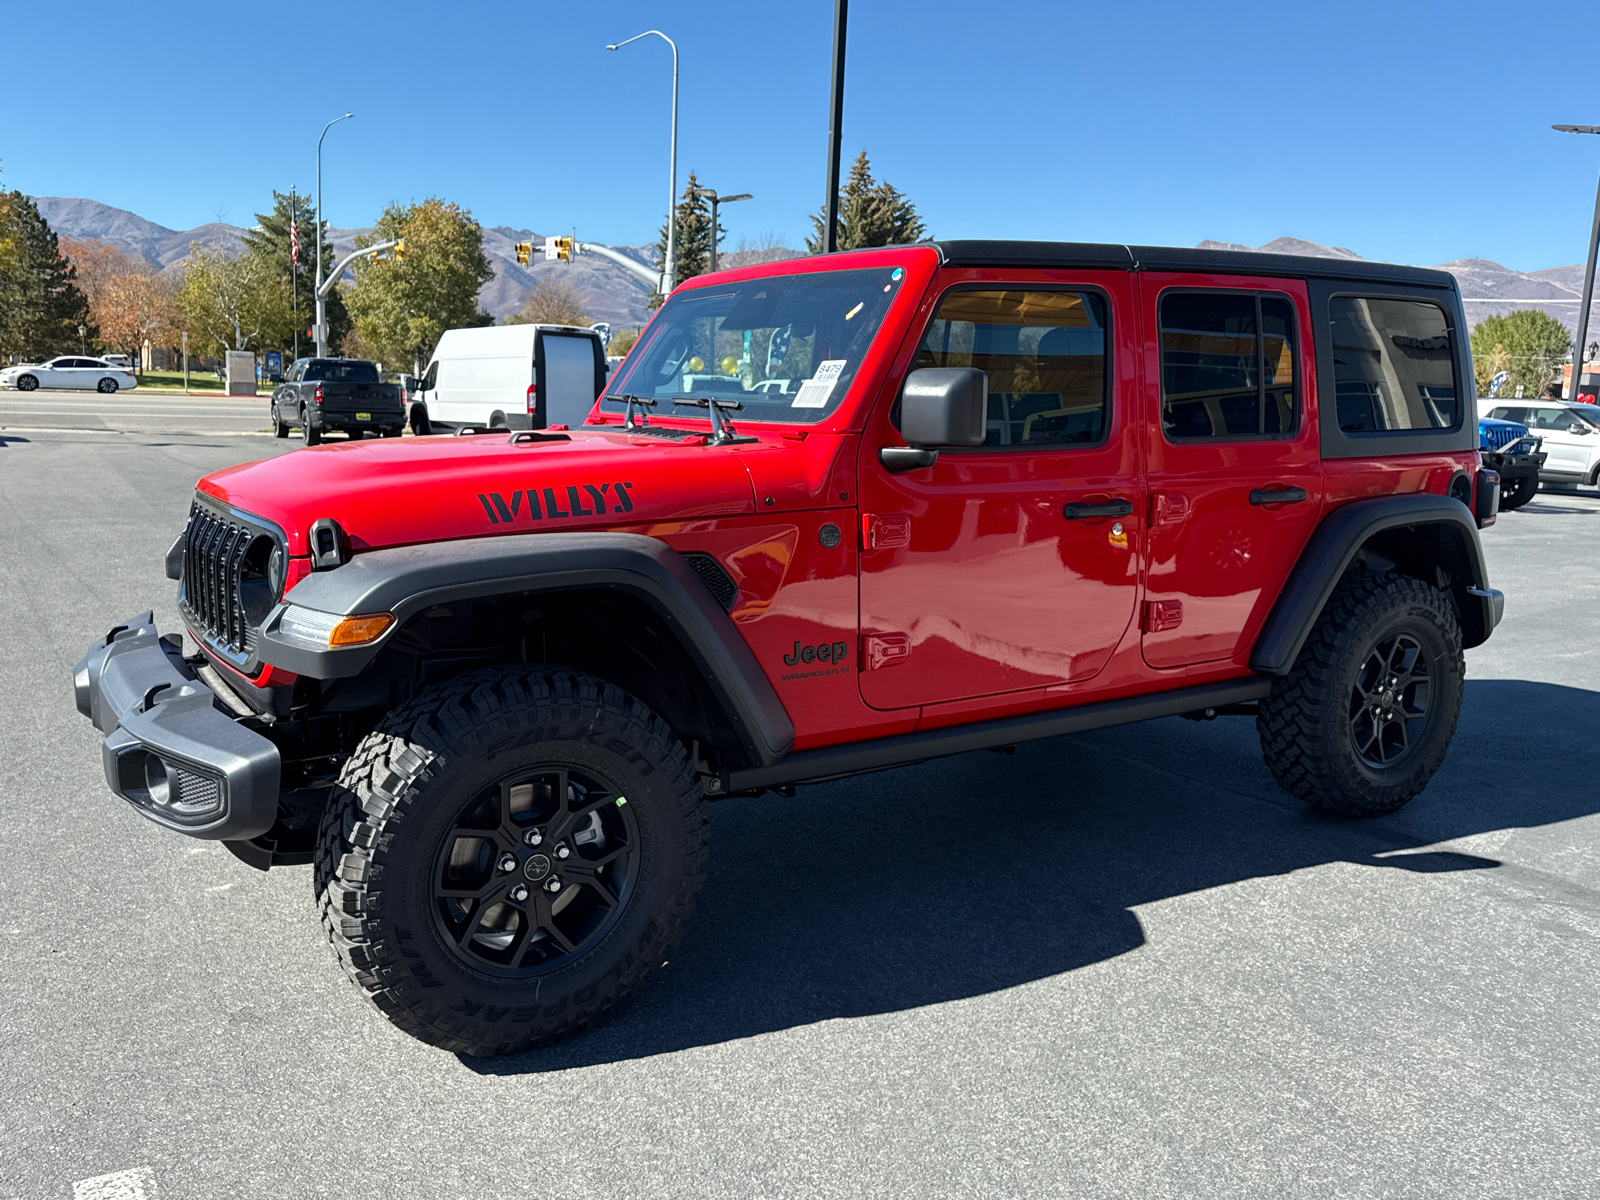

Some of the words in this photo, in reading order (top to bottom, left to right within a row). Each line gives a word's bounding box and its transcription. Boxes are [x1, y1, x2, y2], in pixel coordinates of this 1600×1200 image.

[819, 364, 842, 374] 8479
[477, 481, 633, 524] WILLYS
[783, 641, 848, 666] Jeep
[781, 668, 840, 681] WRANGLER
